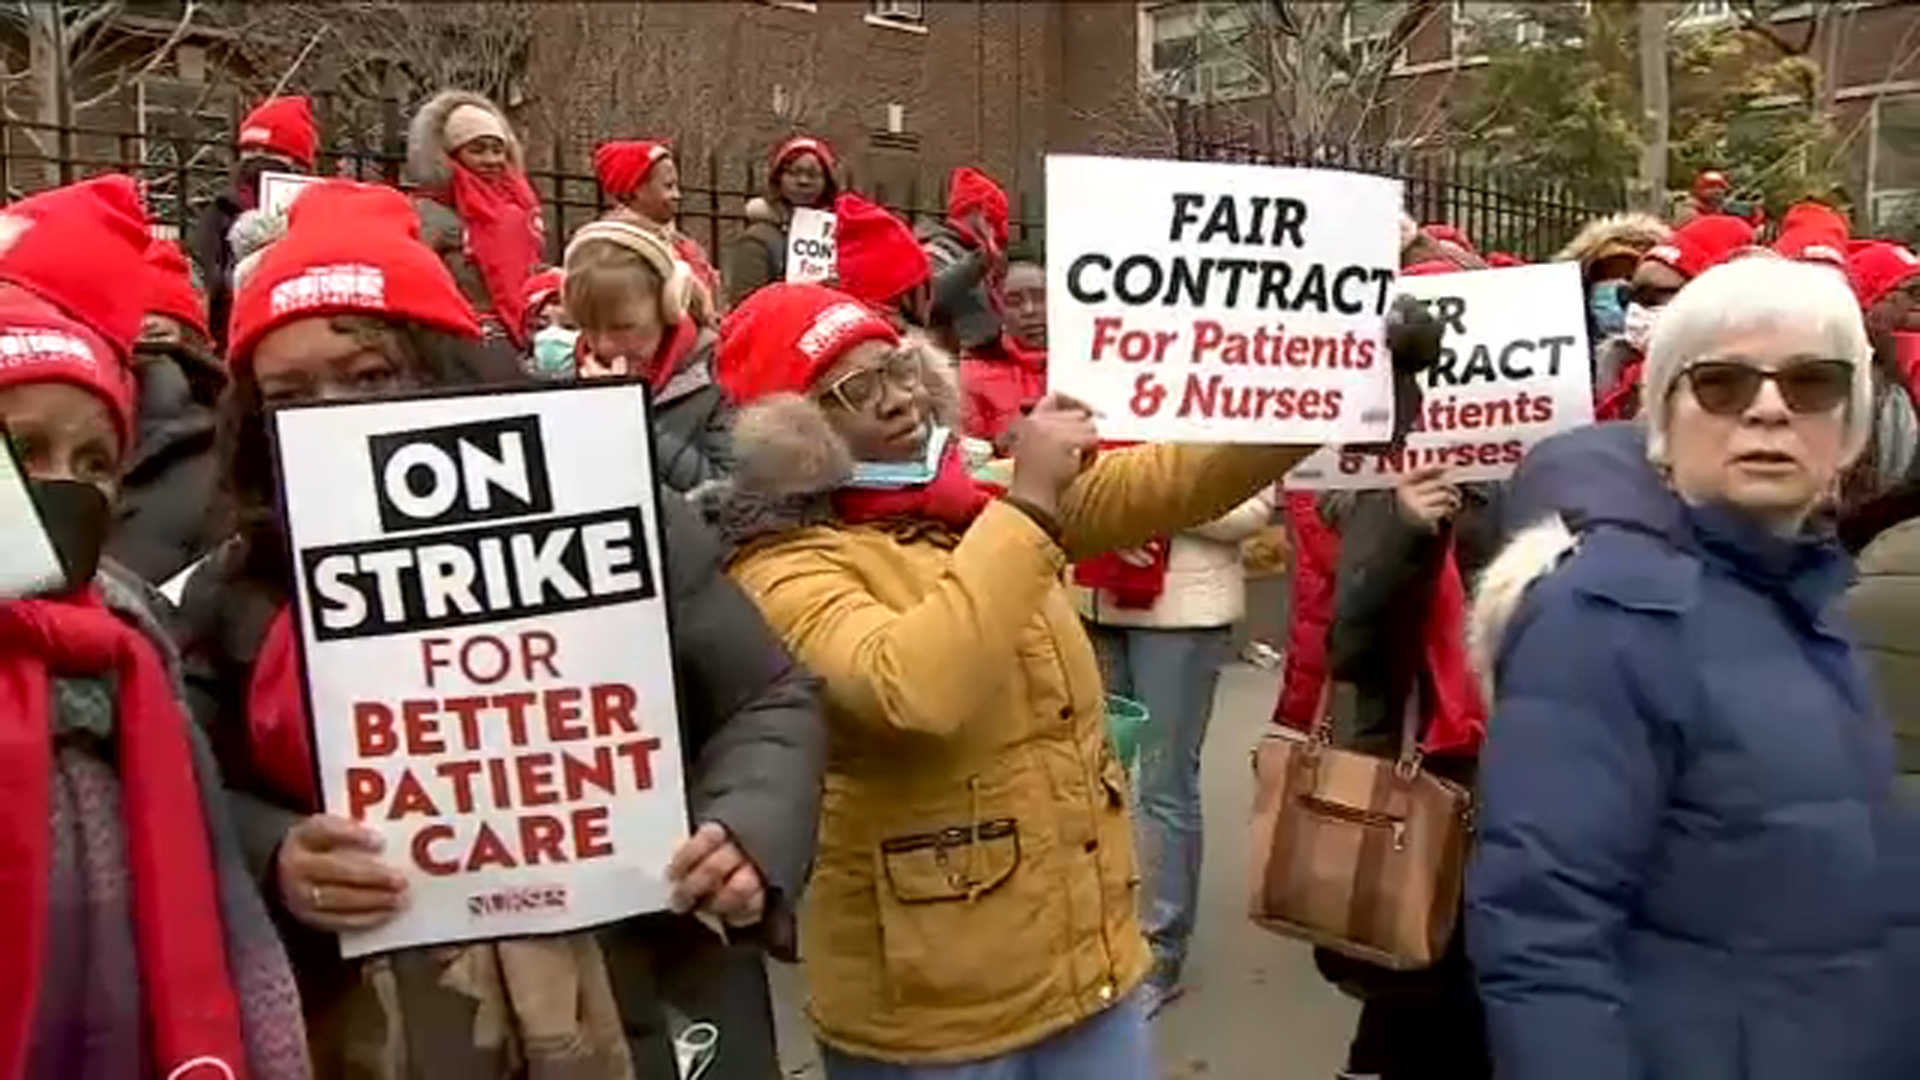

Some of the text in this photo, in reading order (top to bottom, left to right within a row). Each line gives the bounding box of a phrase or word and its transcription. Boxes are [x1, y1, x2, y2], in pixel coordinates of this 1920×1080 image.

[1170, 193, 1308, 247] FAIR
[1067, 253, 1395, 315] CONTRACT
[1090, 317, 1377, 369] For Patients
[1427, 335, 1576, 387] RACT
[1129, 373, 1343, 420] & Nurses
[1417, 392, 1553, 431] tients
[384, 430, 532, 518] ON
[313, 519, 642, 631] STRIKE
[421, 630, 561, 687] FOR
[353, 683, 639, 757] BETTER
[346, 738, 661, 822] PATIENT
[411, 808, 614, 876] CARE
